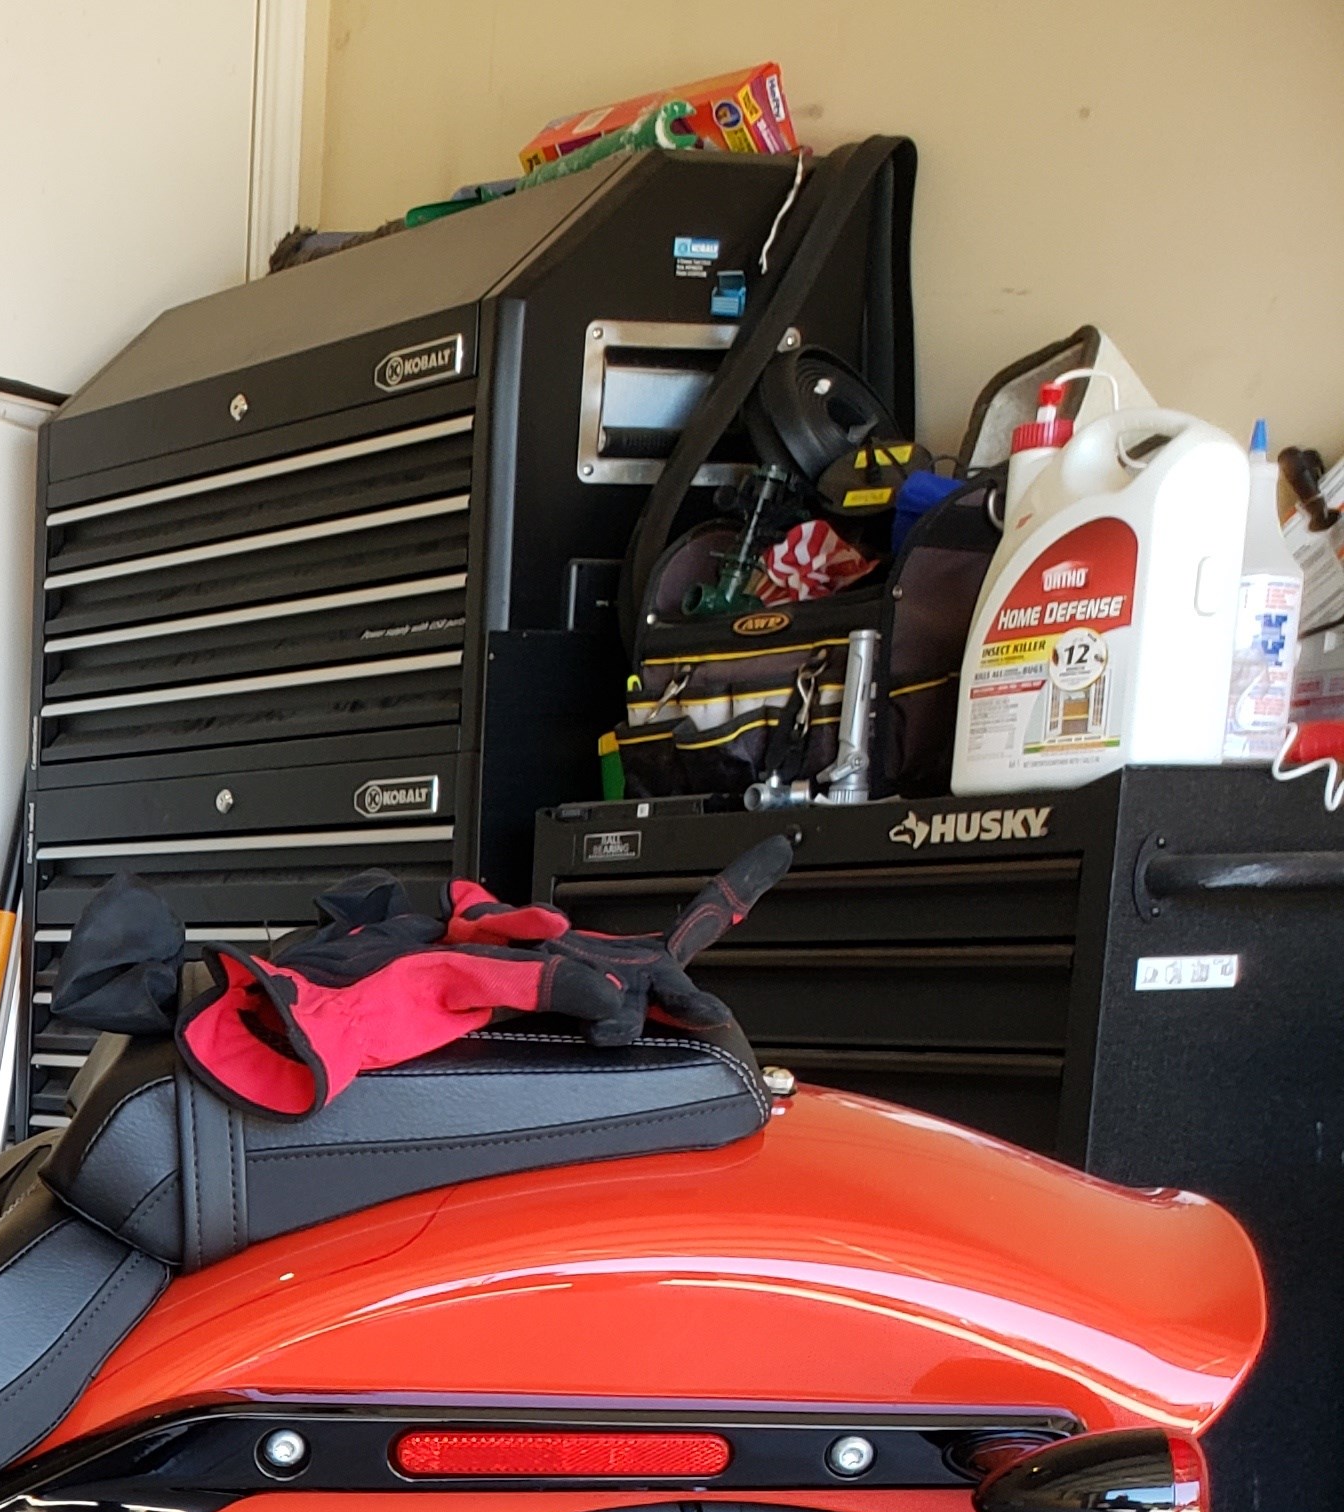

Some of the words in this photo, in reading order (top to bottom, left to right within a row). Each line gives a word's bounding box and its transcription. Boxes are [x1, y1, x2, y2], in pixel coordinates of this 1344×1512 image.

[403, 348, 452, 376] KOBALT
[1043, 567, 1087, 592] ORTHO
[997, 605, 1042, 631] HOME
[1043, 595, 1124, 625] DEFENSE
[981, 645, 1011, 659] INSECT
[1012, 640, 1047, 653] KILLER
[1063, 644, 1091, 666] 12
[382, 787, 429, 806] KOBALT
[929, 806, 1053, 844] HUSKY
